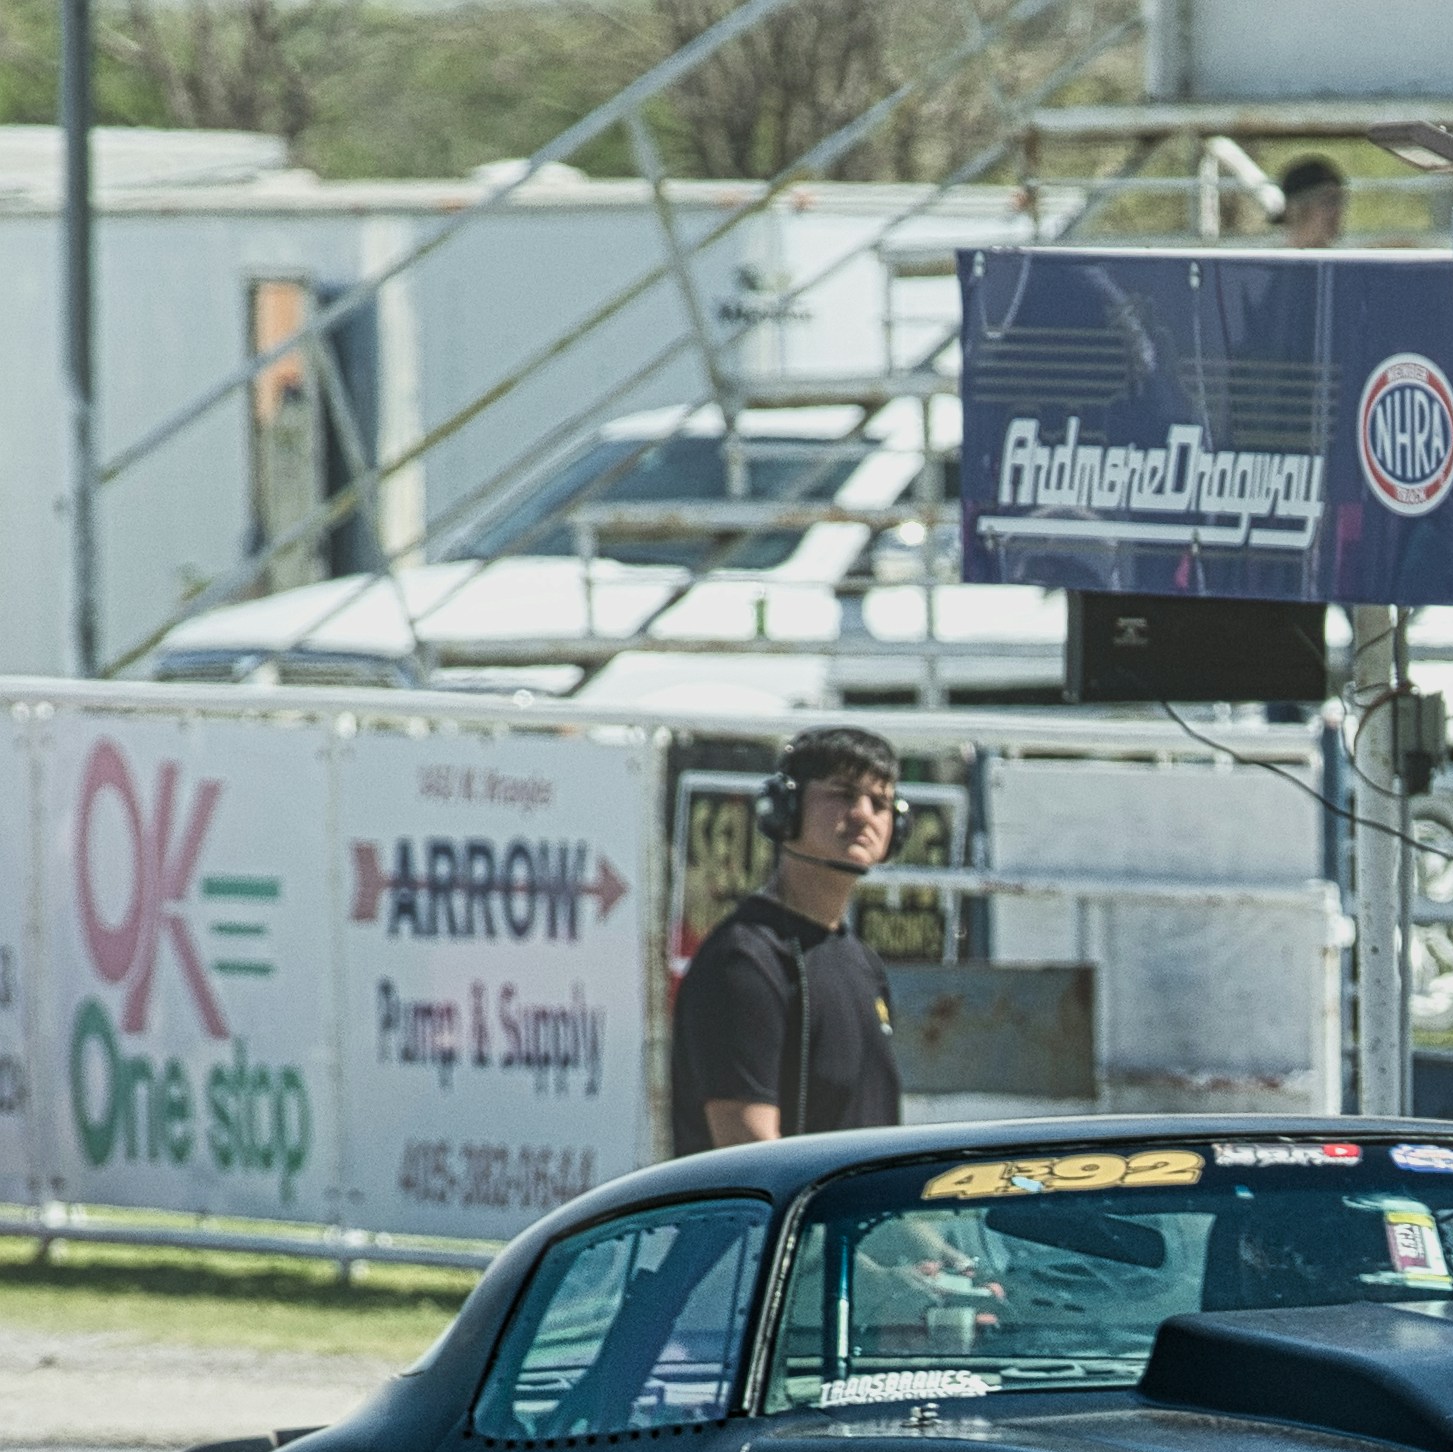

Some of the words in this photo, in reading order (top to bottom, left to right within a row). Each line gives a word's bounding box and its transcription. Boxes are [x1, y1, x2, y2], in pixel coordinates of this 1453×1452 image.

[1375, 387, 1446, 480] NHRA
[75, 735, 231, 1039] OK
[387, 836, 589, 941] ARROW
[375, 975, 457, 1090] Pump
[500, 980, 605, 1098] Supply
[71, 995, 193, 1168] One
[206, 1032, 315, 1206] stop
